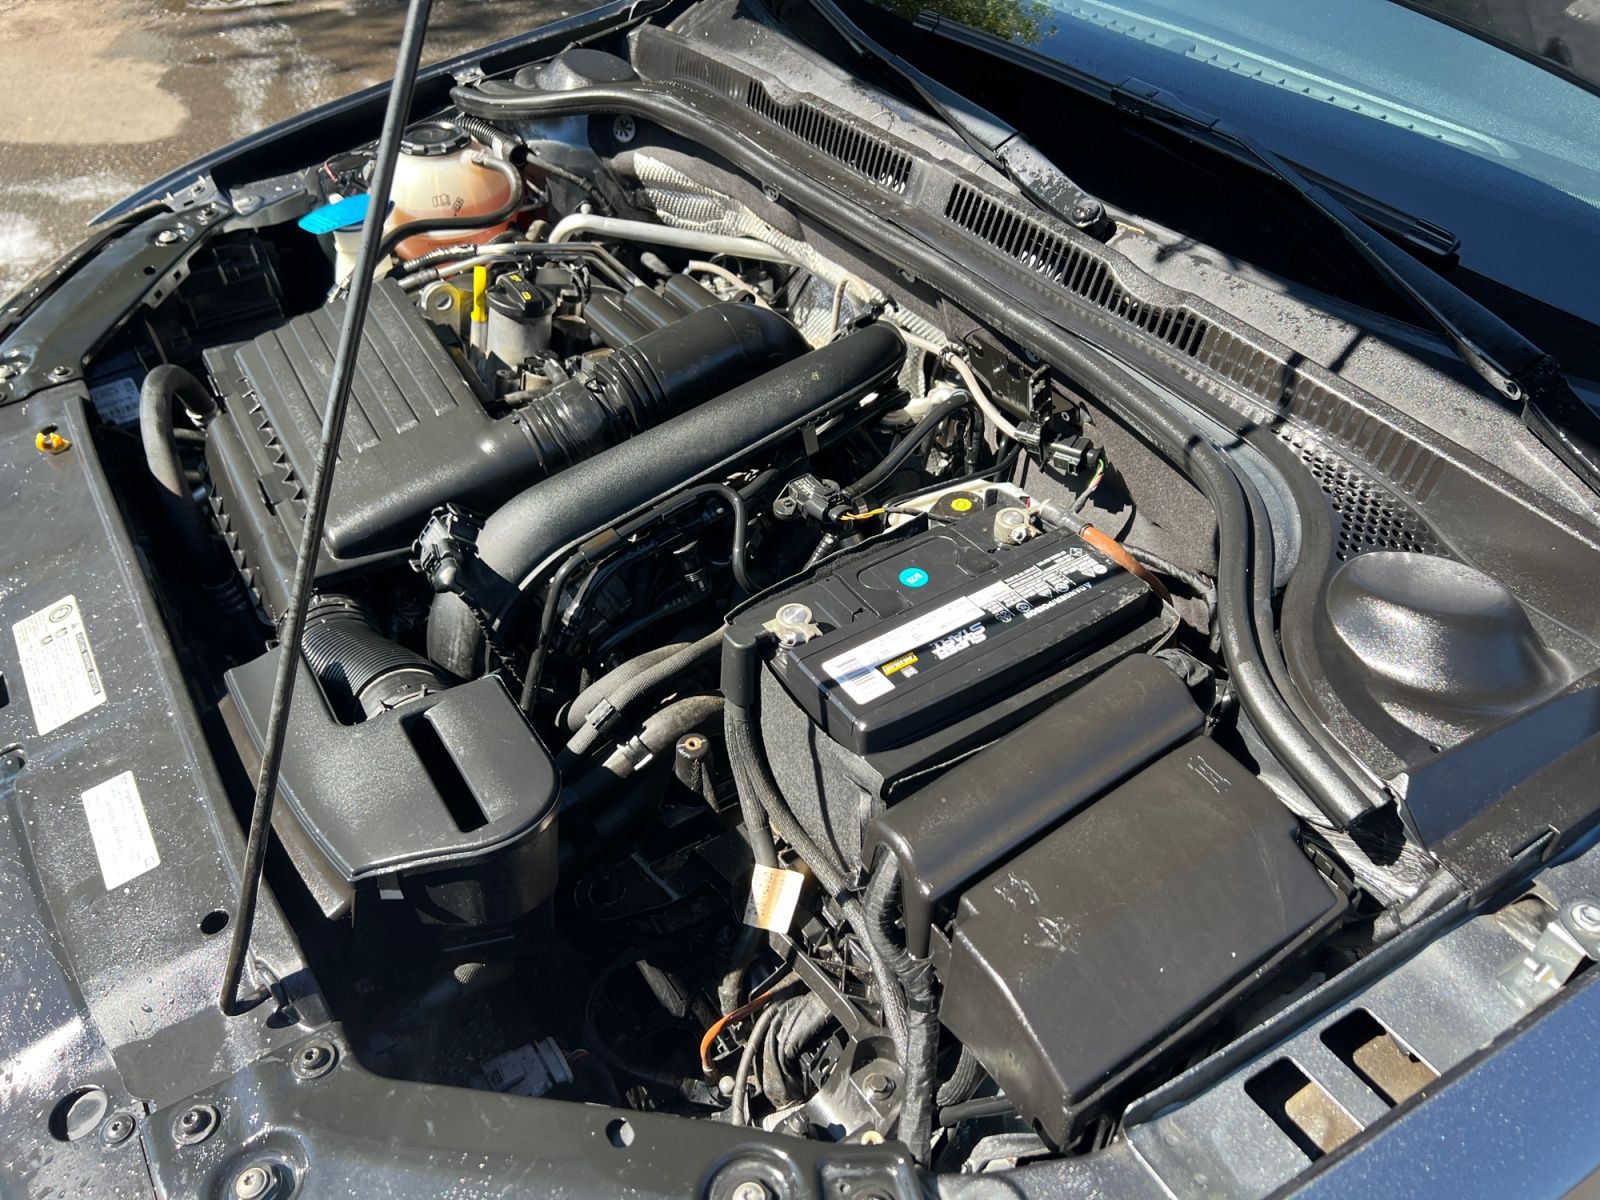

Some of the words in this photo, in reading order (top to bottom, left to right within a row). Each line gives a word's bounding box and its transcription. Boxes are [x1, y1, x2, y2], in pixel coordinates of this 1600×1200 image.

[1023, 584, 1088, 619] DANGER/POISON
[930, 621, 986, 652] START
[931, 633, 987, 660] SUPER
